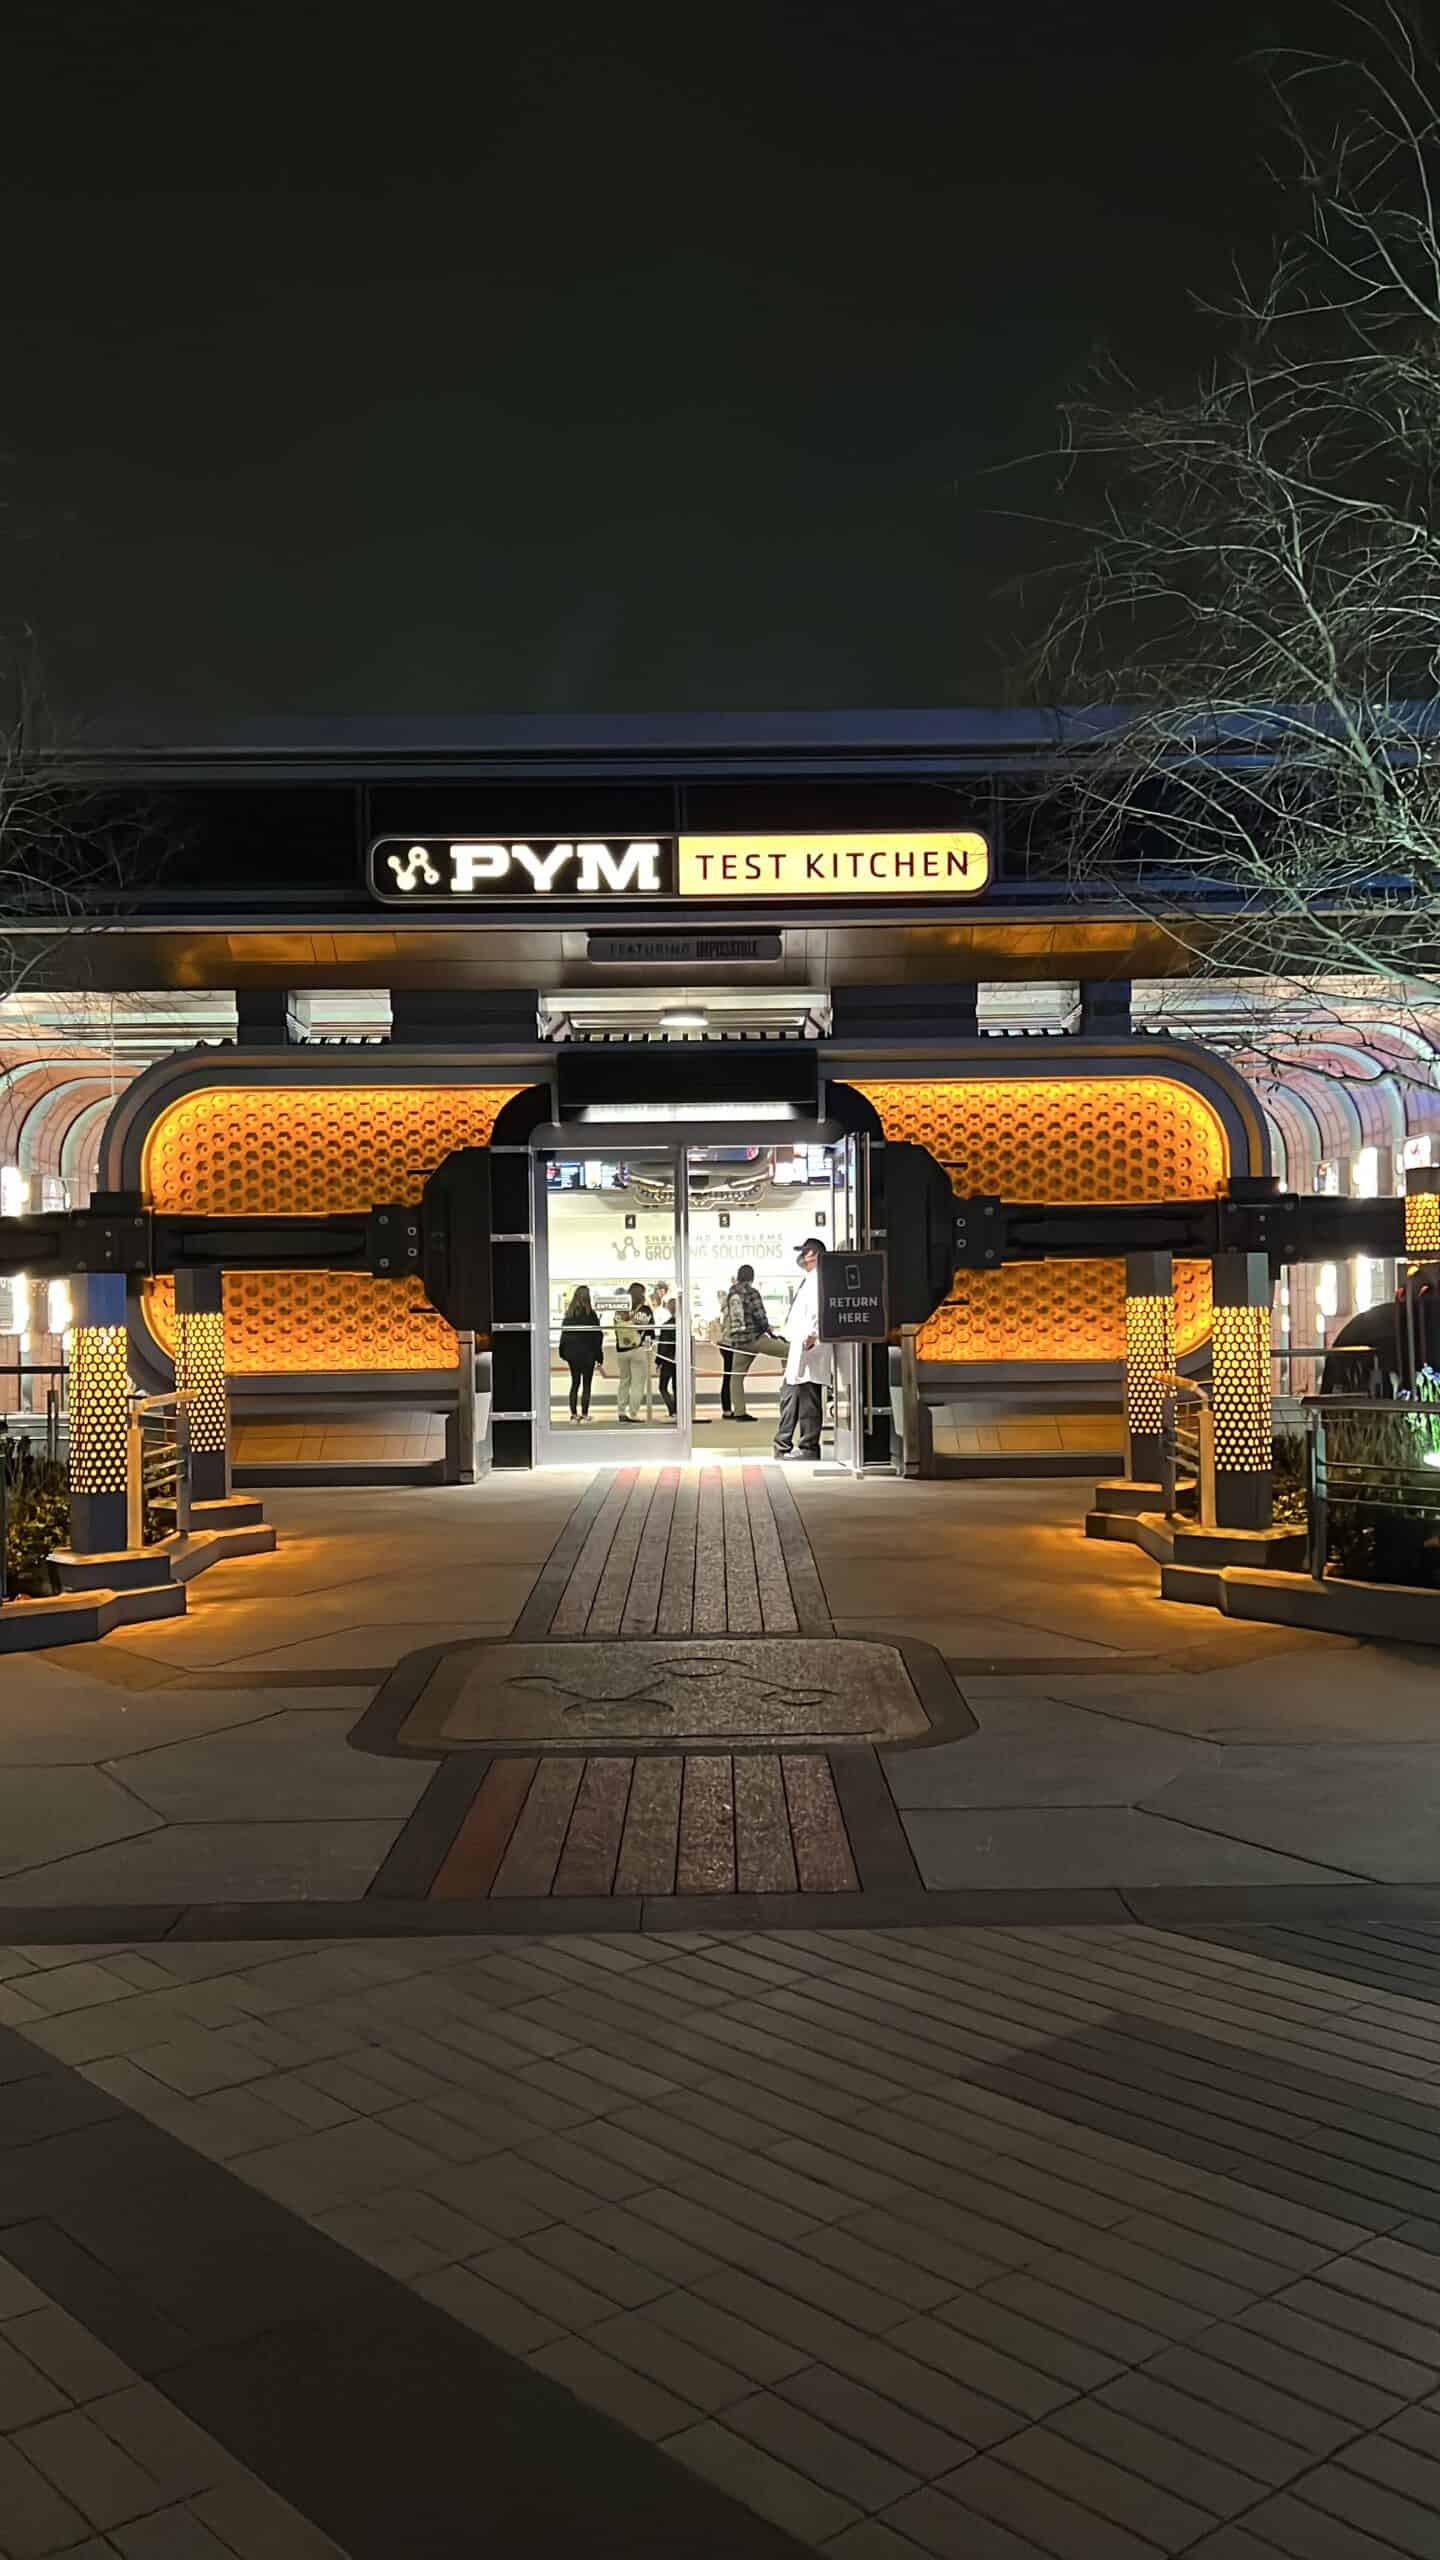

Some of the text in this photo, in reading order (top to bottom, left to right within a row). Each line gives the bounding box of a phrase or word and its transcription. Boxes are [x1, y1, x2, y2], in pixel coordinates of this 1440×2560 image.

[450, 843, 969, 892] PYM TEST KITCHEN
[712, 1244, 784, 1260] SOLUTIONS
[829, 1296, 878, 1308] RETURN
[838, 1312, 871, 1324] HERE
